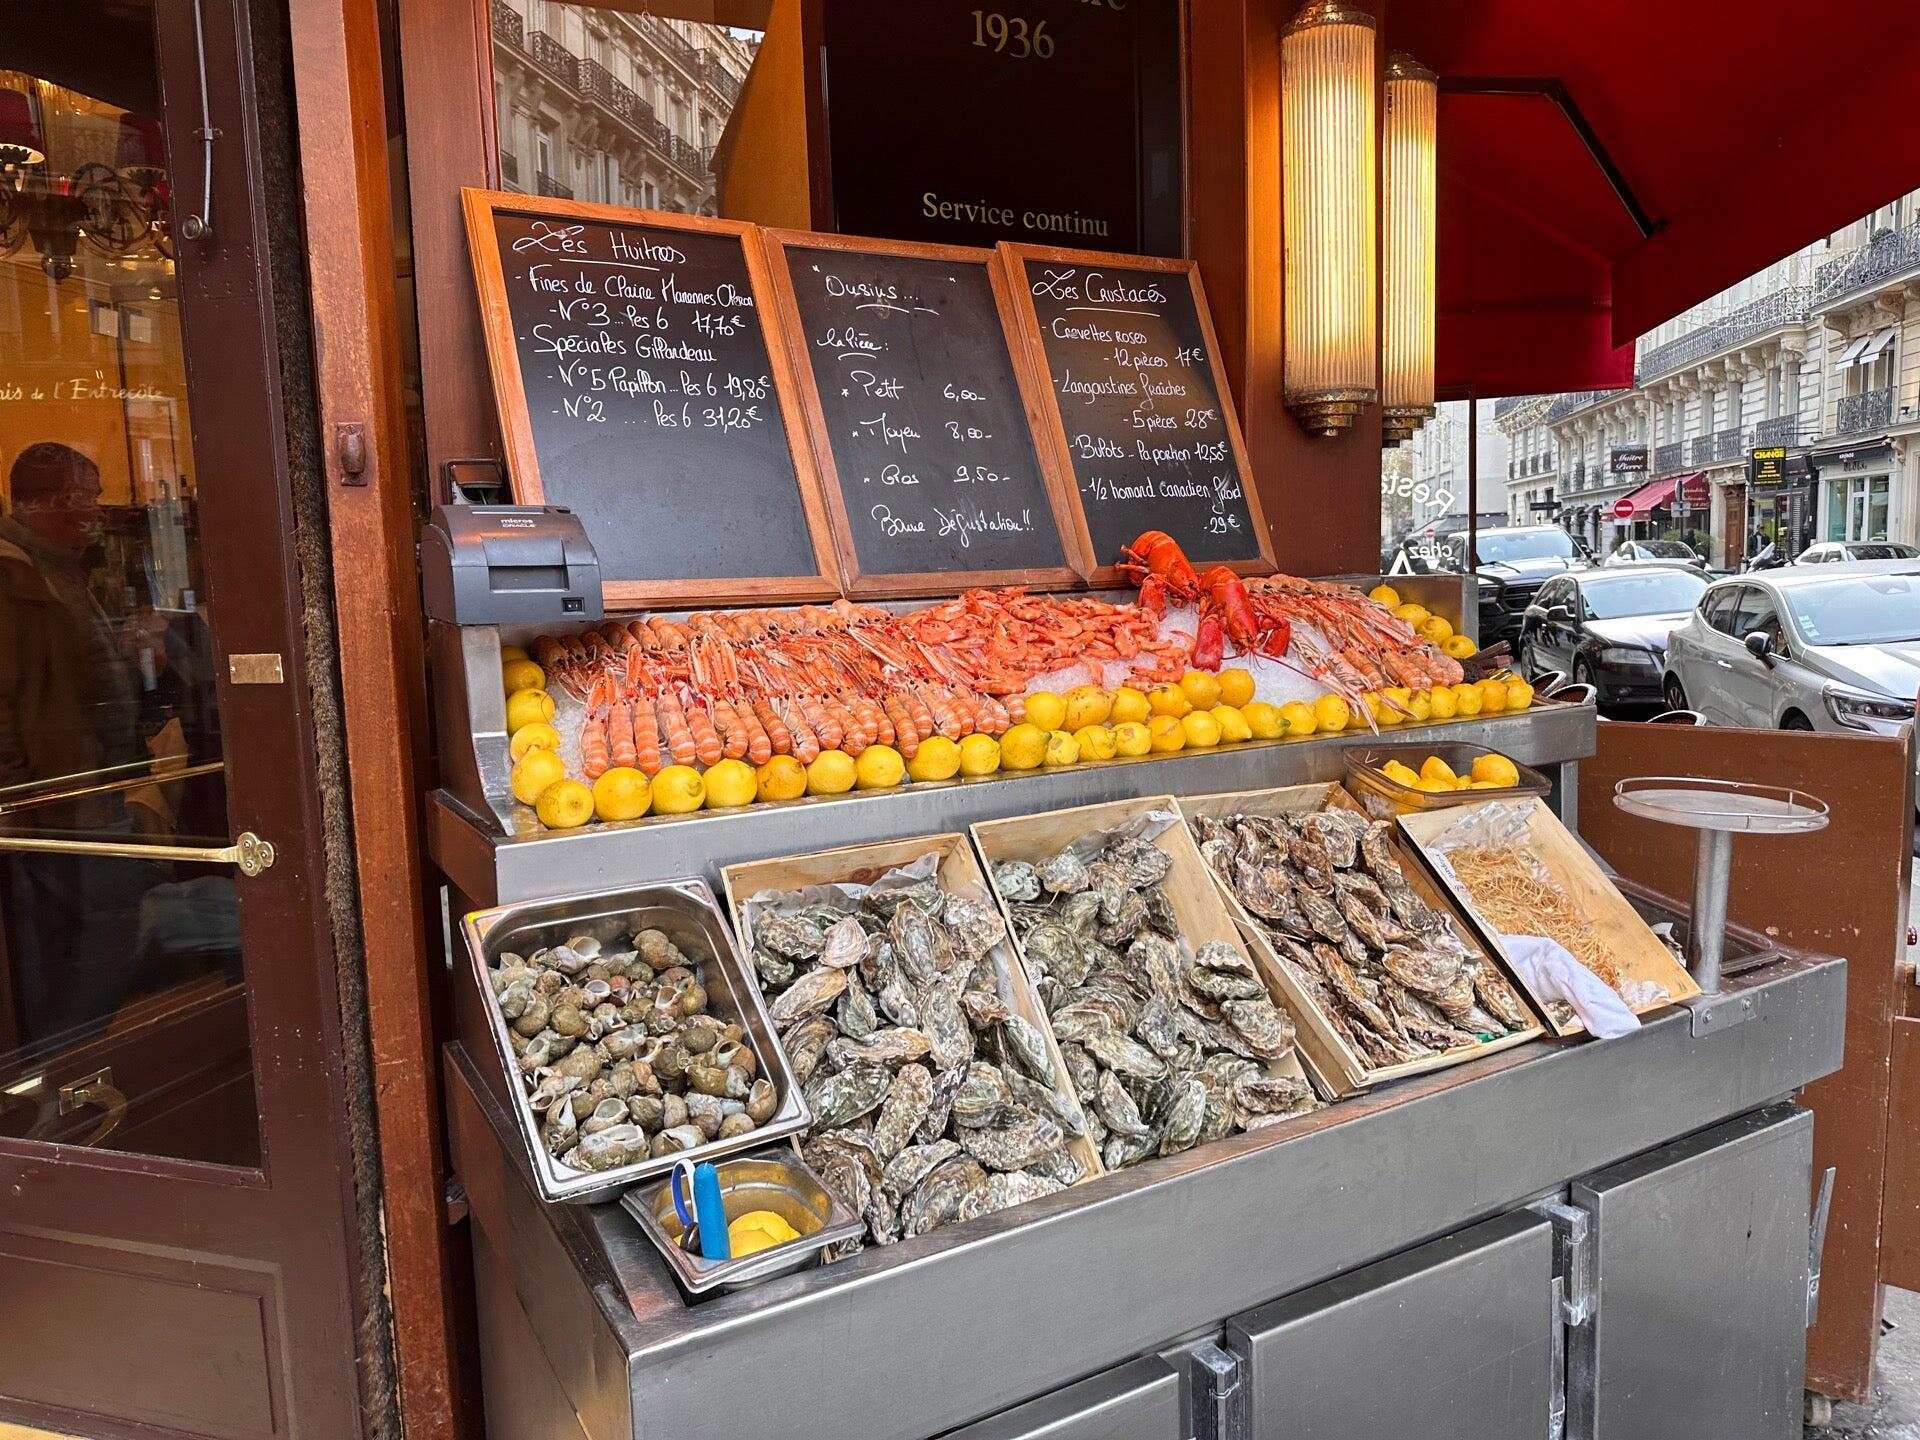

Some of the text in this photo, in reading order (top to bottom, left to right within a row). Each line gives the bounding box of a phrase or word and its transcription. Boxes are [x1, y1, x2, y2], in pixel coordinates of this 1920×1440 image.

[972, 11, 1054, 59] 1936
[922, 192, 1108, 236] Service continu
[513, 221, 587, 254] Les
[529, 264, 569, 292] Fines
[575, 271, 597, 294] de
[605, 274, 656, 299] Claire
[1032, 269, 1079, 301] Les
[656, 306, 669, 330] 6
[635, 333, 718, 362] Gillardeau
[1113, 347, 1133, 368] 12
[1174, 346, 1204, 368] 17€
[31, 387, 44, 400] de
[706, 372, 718, 397] 6
[723, 372, 771, 402] 19,80€
[850, 370, 904, 400] Petit
[1062, 369, 1138, 405] Langoustines
[682, 401, 692, 428] 6
[702, 405, 763, 434] 31,20€
[1132, 409, 1145, 429] 5
[1148, 413, 1178, 433] pièces
[1075, 434, 1125, 460] Bulots
[1194, 440, 1228, 464] 12,50€
[1753, 450, 1785, 460] CHANGE
[881, 464, 919, 485] Gros
[1110, 476, 1156, 500] homard
